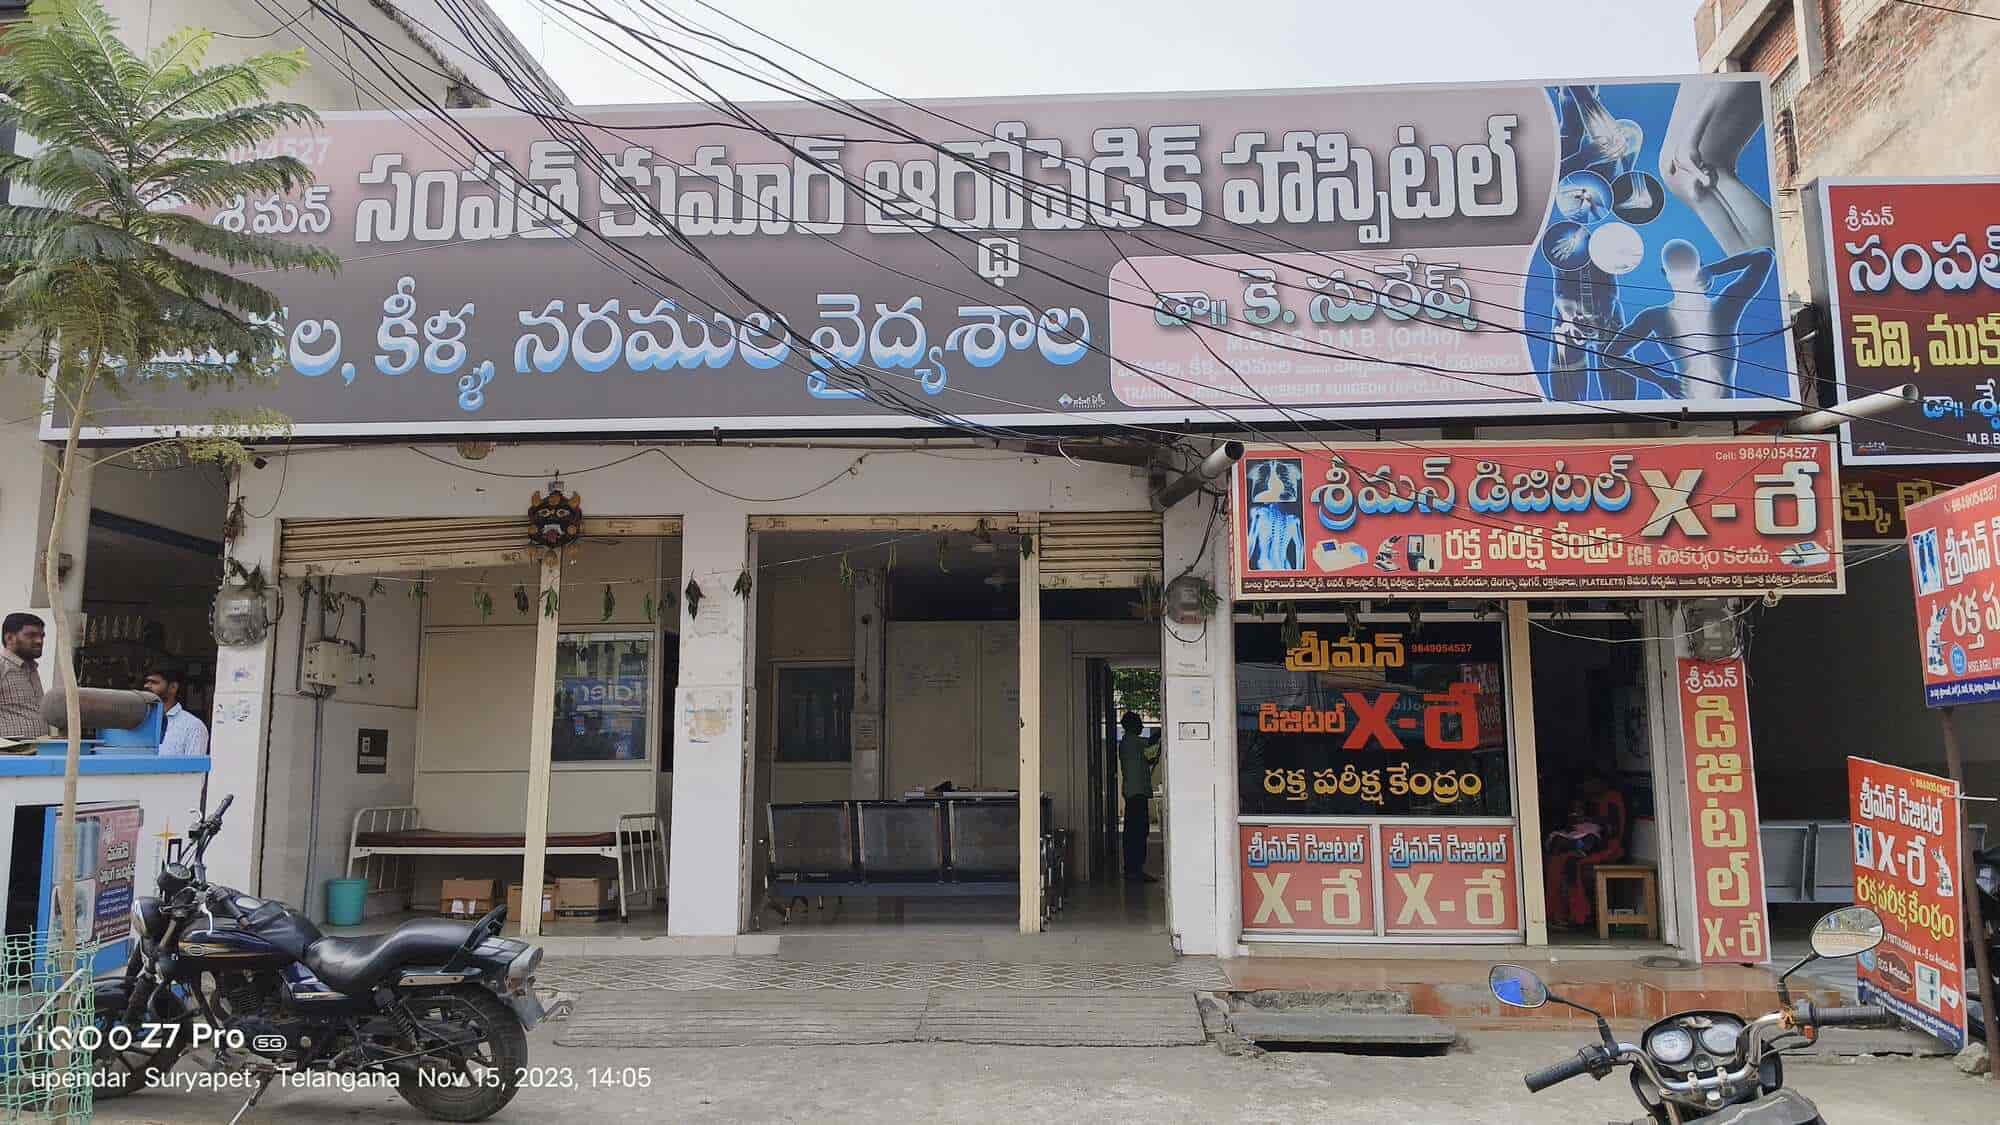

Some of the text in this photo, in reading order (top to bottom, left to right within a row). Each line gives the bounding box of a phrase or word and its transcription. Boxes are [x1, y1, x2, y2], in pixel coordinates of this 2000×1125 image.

[354, 139, 581, 244] సంపత్
[599, 135, 846, 238] కుమార్
[1221, 114, 1519, 244] హాస్పిటల్
[1845, 206, 1895, 231] శ్రీమన్
[1306, 253, 1479, 331] సురేష్
[514, 297, 792, 373] నరముల
[1852, 314, 1920, 373] చెవి,
[1715, 447, 1817, 461] Cell: 9849054527
[1311, 456, 1456, 531] శ్రీమన్
[1468, 454, 1633, 514] డిజిటల్
[1446, 528, 1482, 570] రక్త
[1551, 521, 1624, 567] కేంద్రం
[1285, 631, 1405, 672] శ్రీమన్
[1685, 666, 1738, 693] శ్రీమన్
[1259, 703, 1345, 734] డిజిటల్
[1263, 762, 1482, 805] రక్త పరీక్ష కేంద్రం
[1248, 832, 1365, 867] శ్రీమన్ డిజిటల్
[1389, 832, 1507, 868] శ్రీమన్ డిజిటల్
